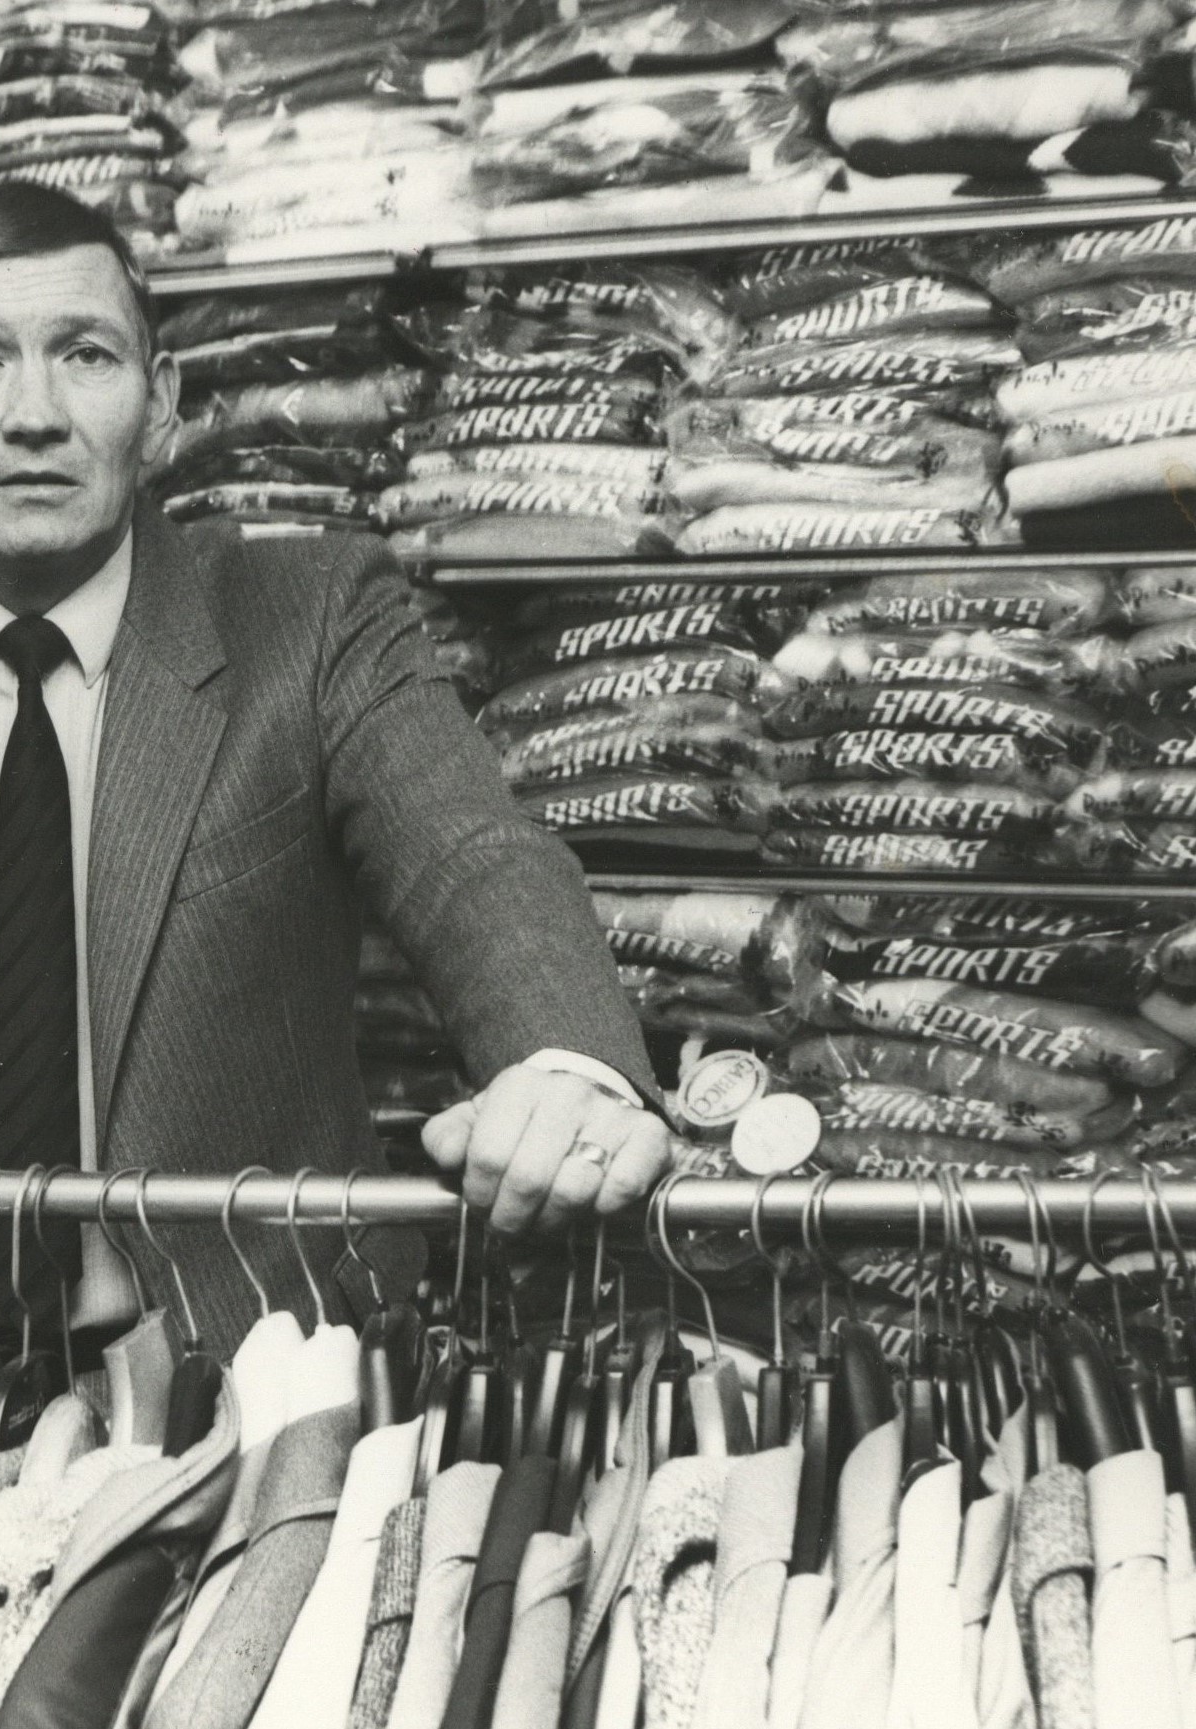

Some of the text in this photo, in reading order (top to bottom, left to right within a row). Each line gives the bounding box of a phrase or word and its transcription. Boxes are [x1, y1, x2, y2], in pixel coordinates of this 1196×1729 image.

[447, 402, 611, 444] SPORTS
[556, 602, 723, 662] SPORTS
[868, 689, 1055, 739] SPORTS
[834, 728, 1019, 770] SPORTS
[872, 937, 1062, 986] SPORTS
[898, 1000, 1086, 1068] SPORTS
